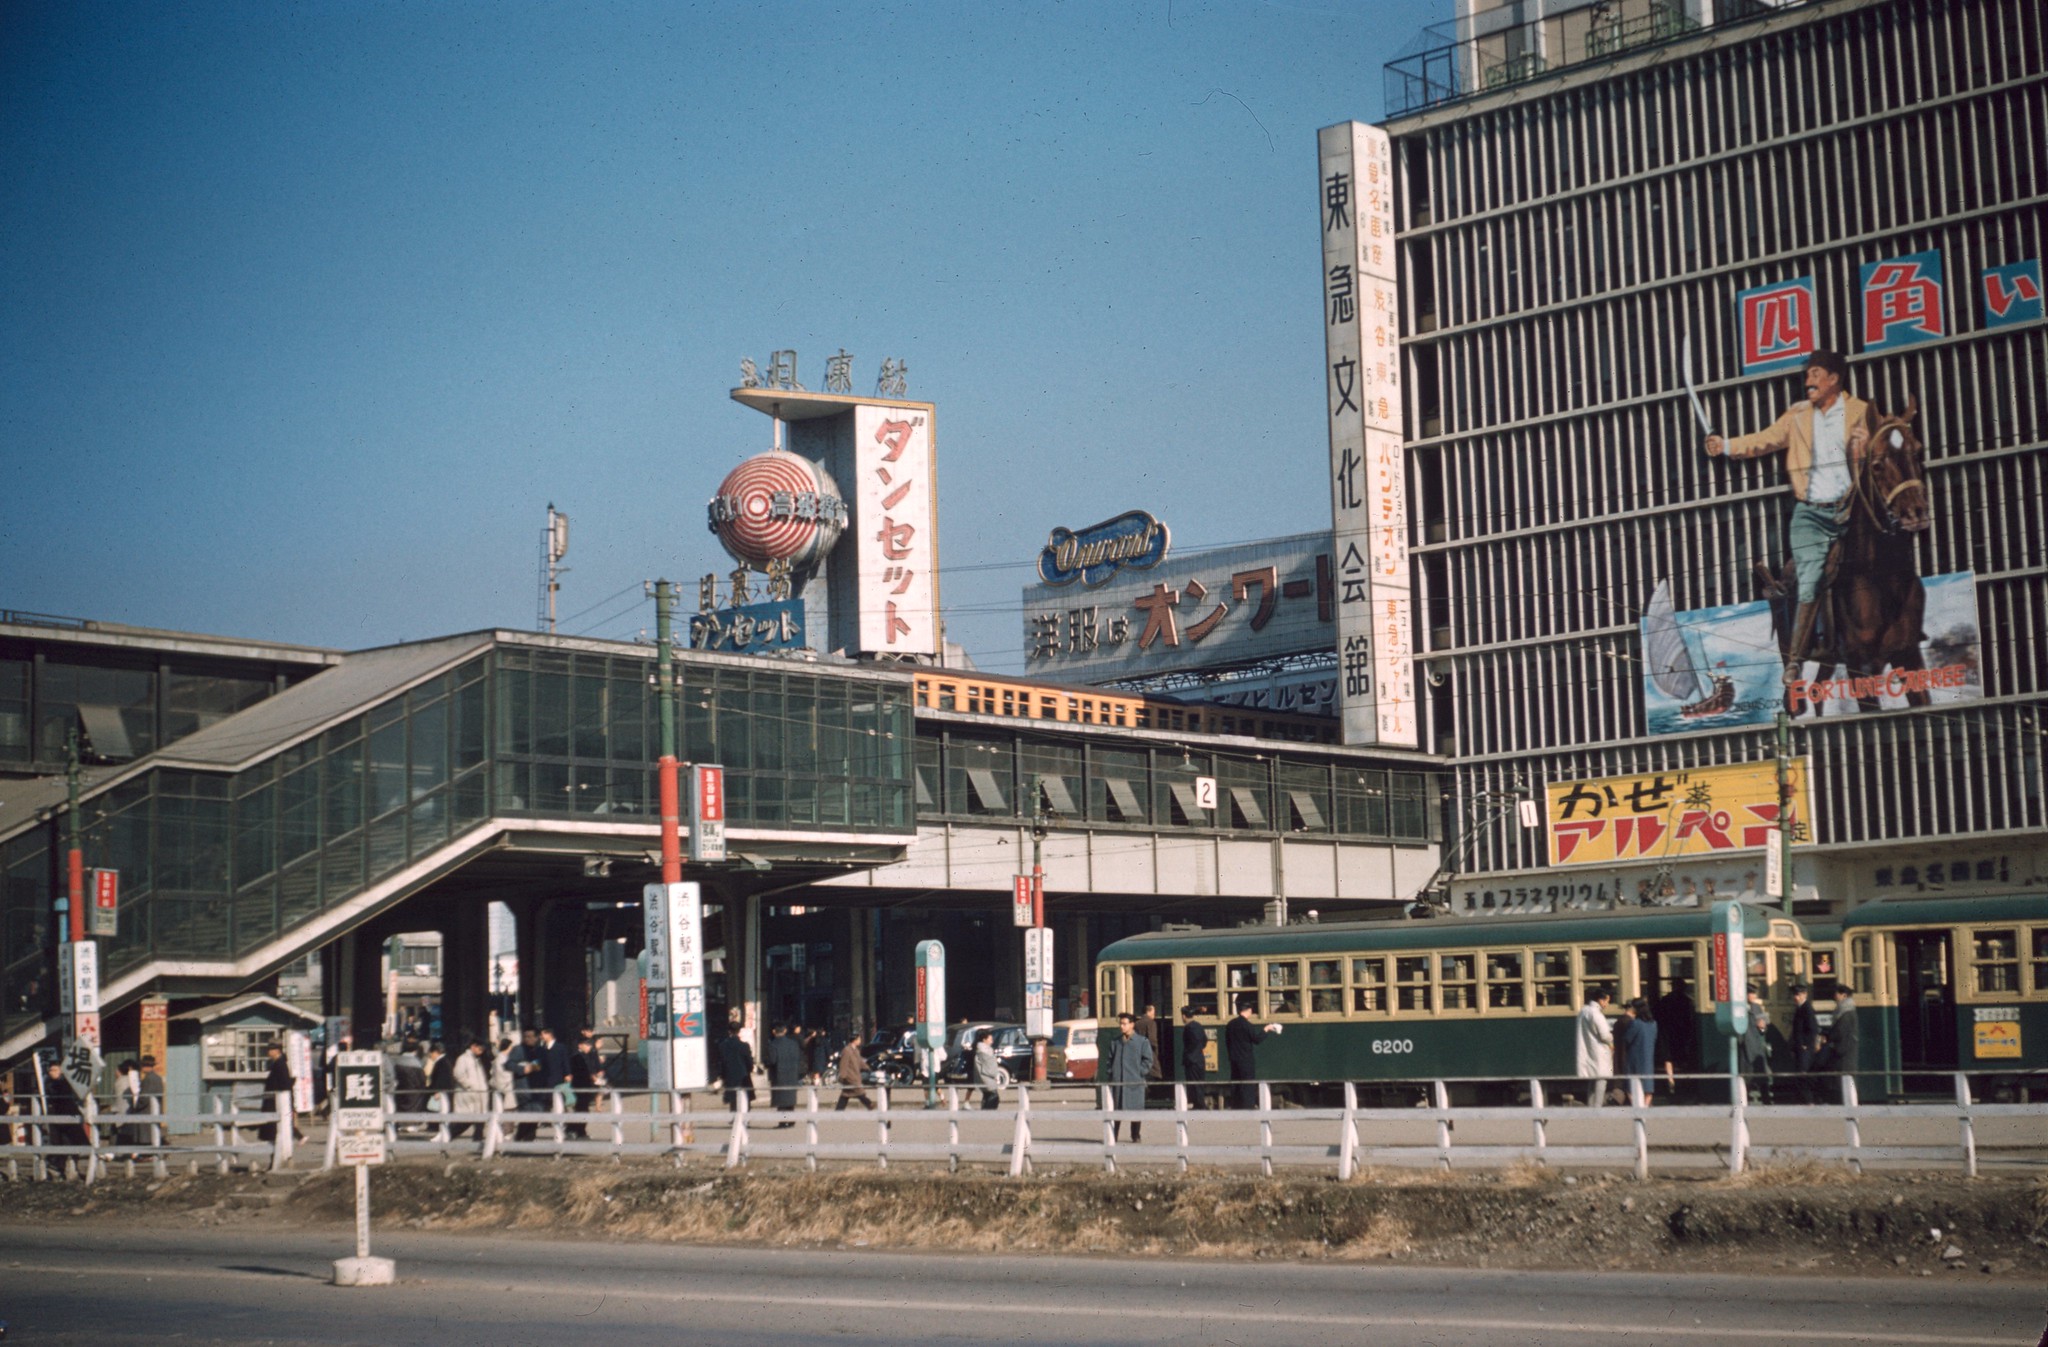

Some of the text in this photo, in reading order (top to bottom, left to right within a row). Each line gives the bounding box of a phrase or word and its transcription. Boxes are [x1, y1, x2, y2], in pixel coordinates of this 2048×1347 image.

[874, 416, 924, 644] ダンセット
[1055, 521, 1160, 572] Onward
[691, 609, 801, 649] ダンセット
[1032, 605, 1129, 659] 洋服は
[1789, 664, 1967, 714] FORTUNE CARREE
[1201, 781, 1211, 804] 2
[1558, 773, 1712, 819] かぜ薬
[1553, 804, 1797, 864] アルペン
[66, 1046, 93, 1087] 場
[1371, 1038, 1414, 1054] 6200
[345, 1073, 375, 1100] 駐
